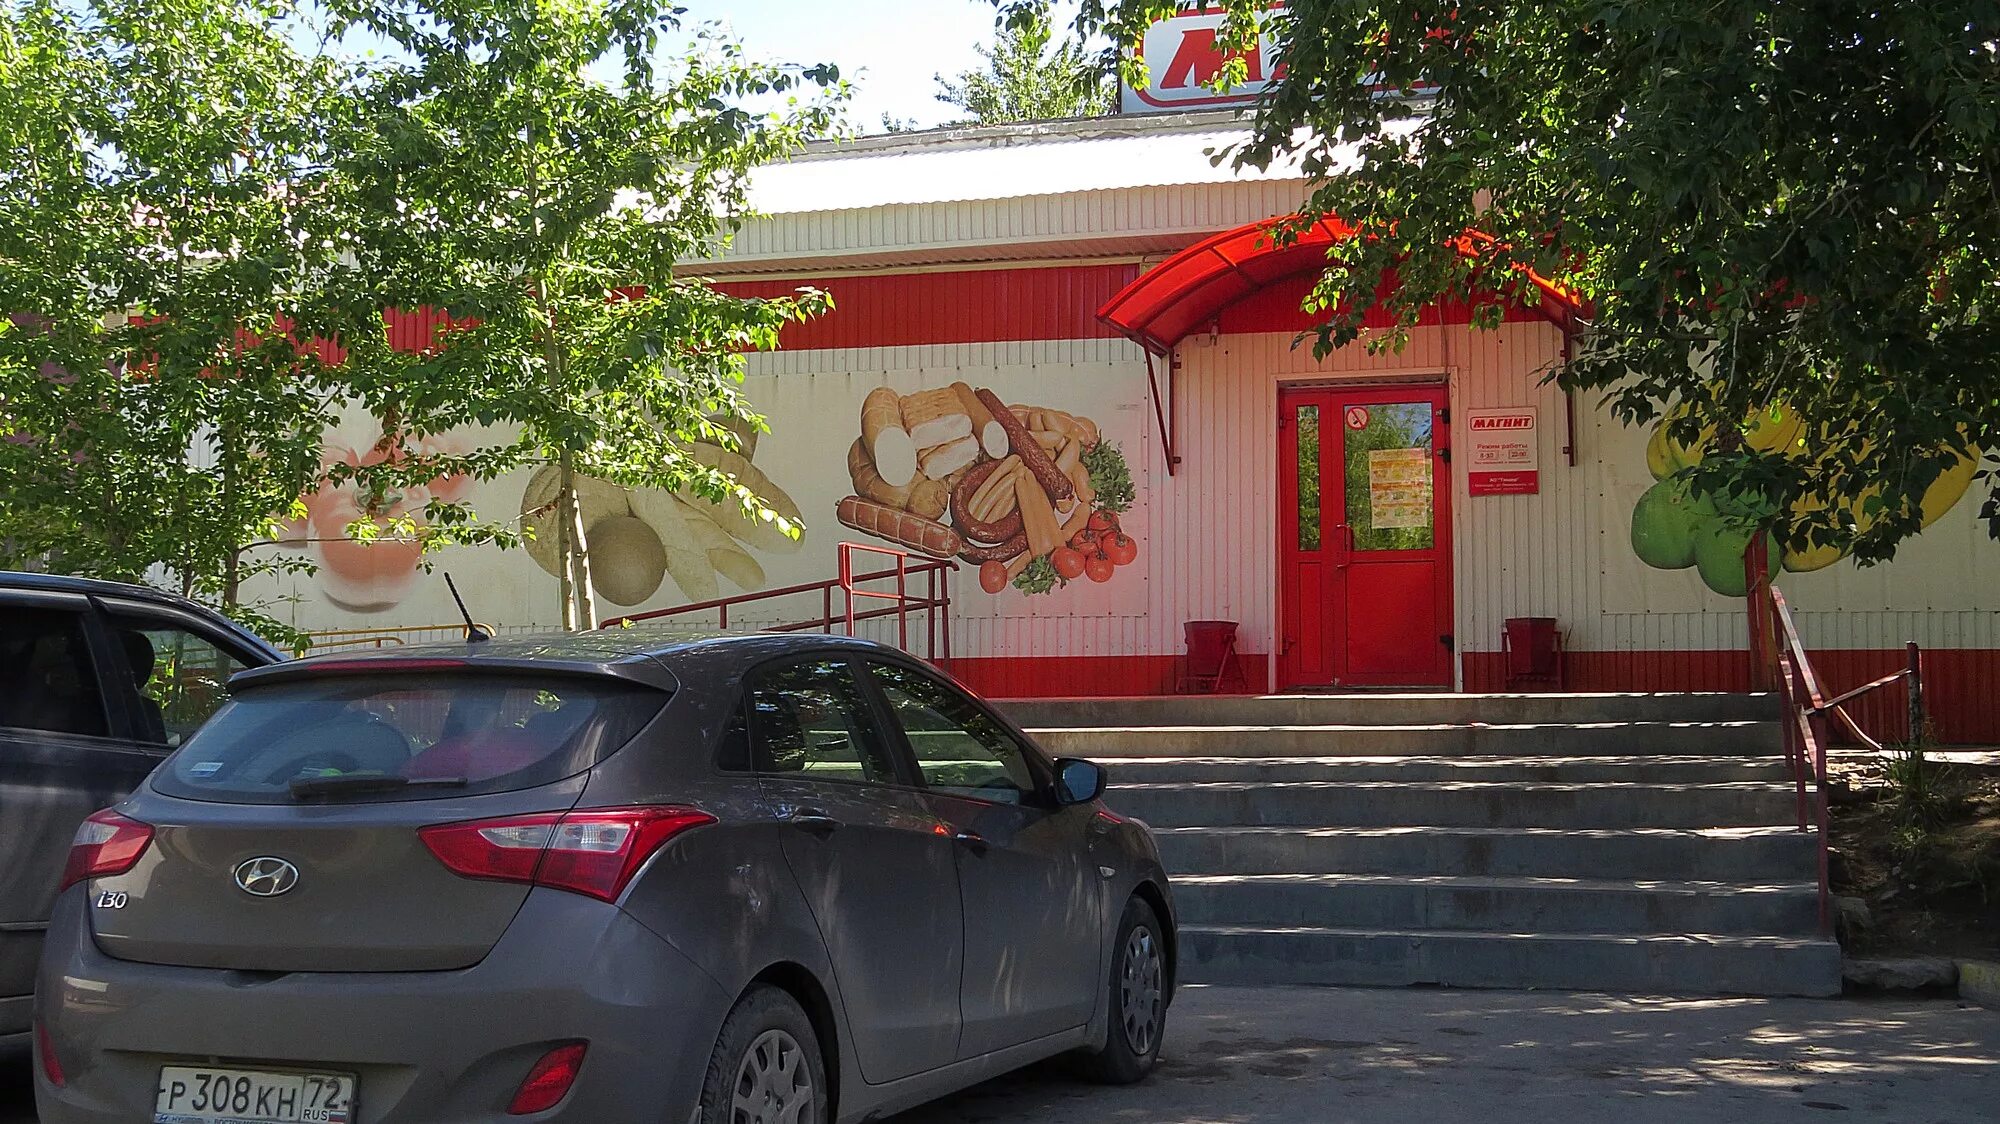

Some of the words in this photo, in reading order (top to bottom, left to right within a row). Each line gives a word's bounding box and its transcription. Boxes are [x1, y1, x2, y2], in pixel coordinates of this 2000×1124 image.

[1473, 418, 1531, 428] МАГНИТ
[97, 891, 127, 909] i30
[308, 1077, 342, 1109] 72
[303, 1108, 328, 1122] RUS
